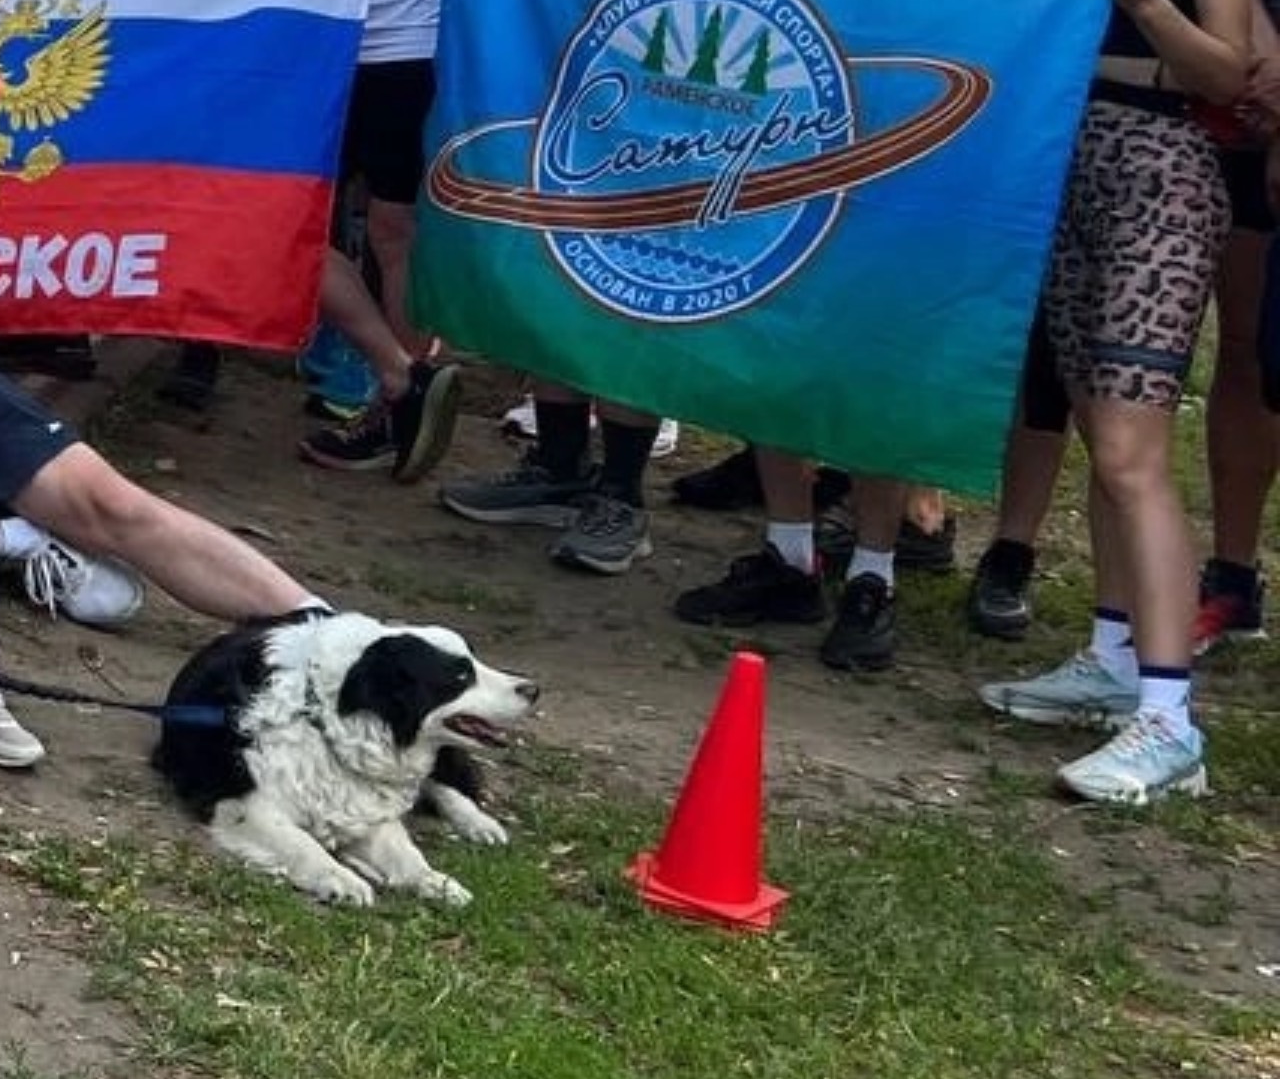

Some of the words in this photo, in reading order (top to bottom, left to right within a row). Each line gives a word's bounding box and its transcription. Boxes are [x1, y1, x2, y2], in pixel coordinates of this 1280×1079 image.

[773, 4, 837, 94] СПОРТА
[564, 238, 654, 310] ОСНОВАН
[681, 283, 739, 313] 2020
